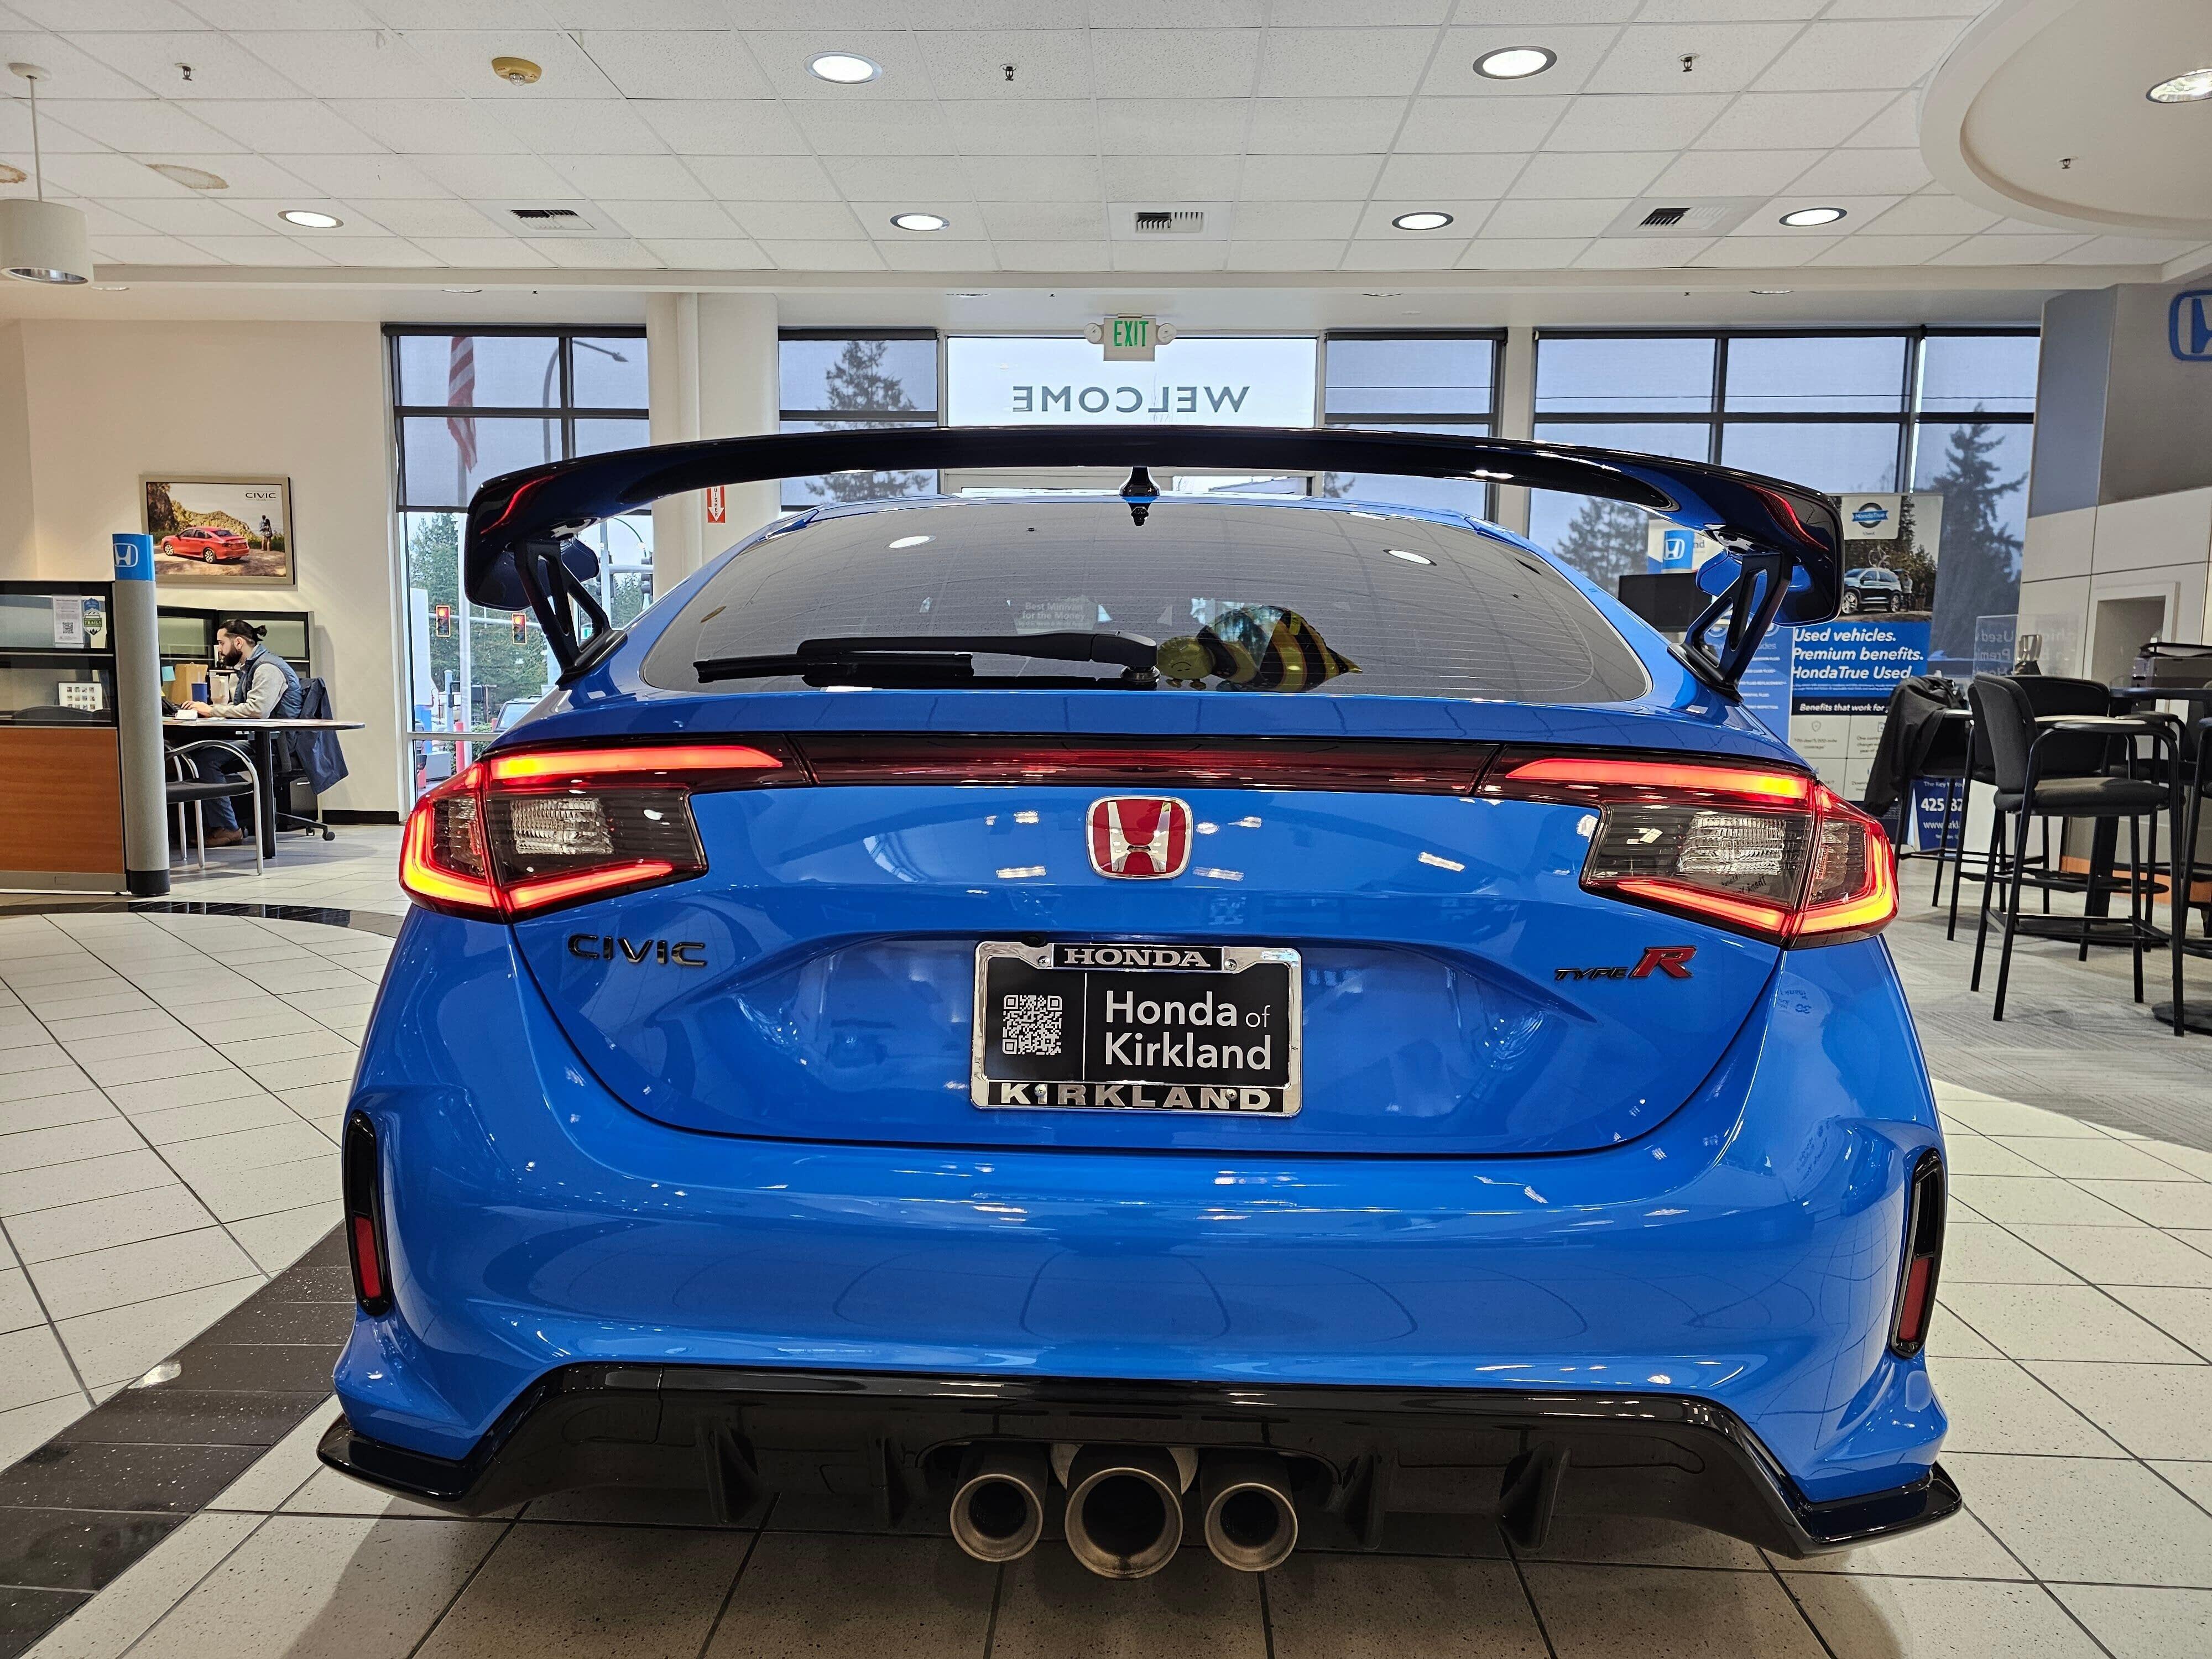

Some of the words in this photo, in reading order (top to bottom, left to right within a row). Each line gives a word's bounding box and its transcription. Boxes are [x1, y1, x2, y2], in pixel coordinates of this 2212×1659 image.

[1114, 320, 1149, 347] EXIT
[1693, 540, 1705, 548] nd
[1794, 627, 1831, 641] Used
[1834, 627, 1896, 641] vehicles.
[1793, 647, 1856, 660] Premium
[1860, 646, 1924, 660] benefits.
[1799, 703, 1833, 712] Benefits
[1834, 703, 1850, 712] that
[1851, 703, 1872, 712] work
[1872, 703, 1885, 712] for
[567, 932, 708, 967] CIVIC
[1064, 948, 1211, 968] HONDA
[1554, 966, 1629, 980] TYPE
[1629, 945, 1698, 978] R
[1105, 990, 1237, 1027] Honda
[1245, 1005, 1271, 1028] of
[1105, 1032, 1271, 1070] Kirkland
[1000, 1082, 1270, 1110] KIRKLAND
